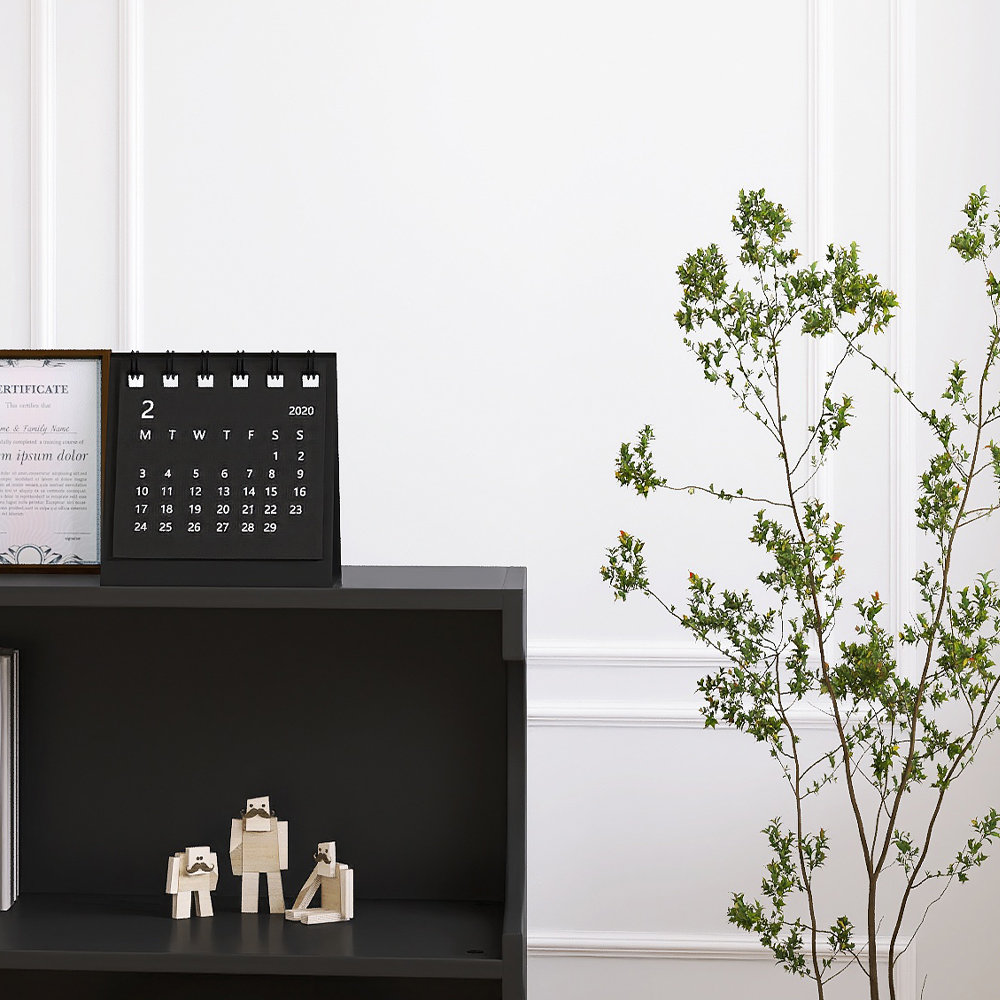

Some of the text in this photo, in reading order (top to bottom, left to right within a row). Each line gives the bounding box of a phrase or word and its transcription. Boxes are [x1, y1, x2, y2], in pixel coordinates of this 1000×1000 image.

[141, 400, 314, 418] 2 2020
[23, 424, 48, 435] Family
[51, 424, 70, 432] Name
[140, 430, 303, 440] M T W T F S S
[16, 449, 53, 465] ipsum
[56, 448, 89, 461] dolor
[273, 452, 304, 461] 1 2
[140, 469, 303, 478] 3 4 5 6 7 8 9
[136, 486, 306, 496] 10 11 12 13 14 15 16
[136, 505, 302, 514] 17 18 19 20 21 22 23
[135, 522, 276, 532] 24 25 26 27 28 29
